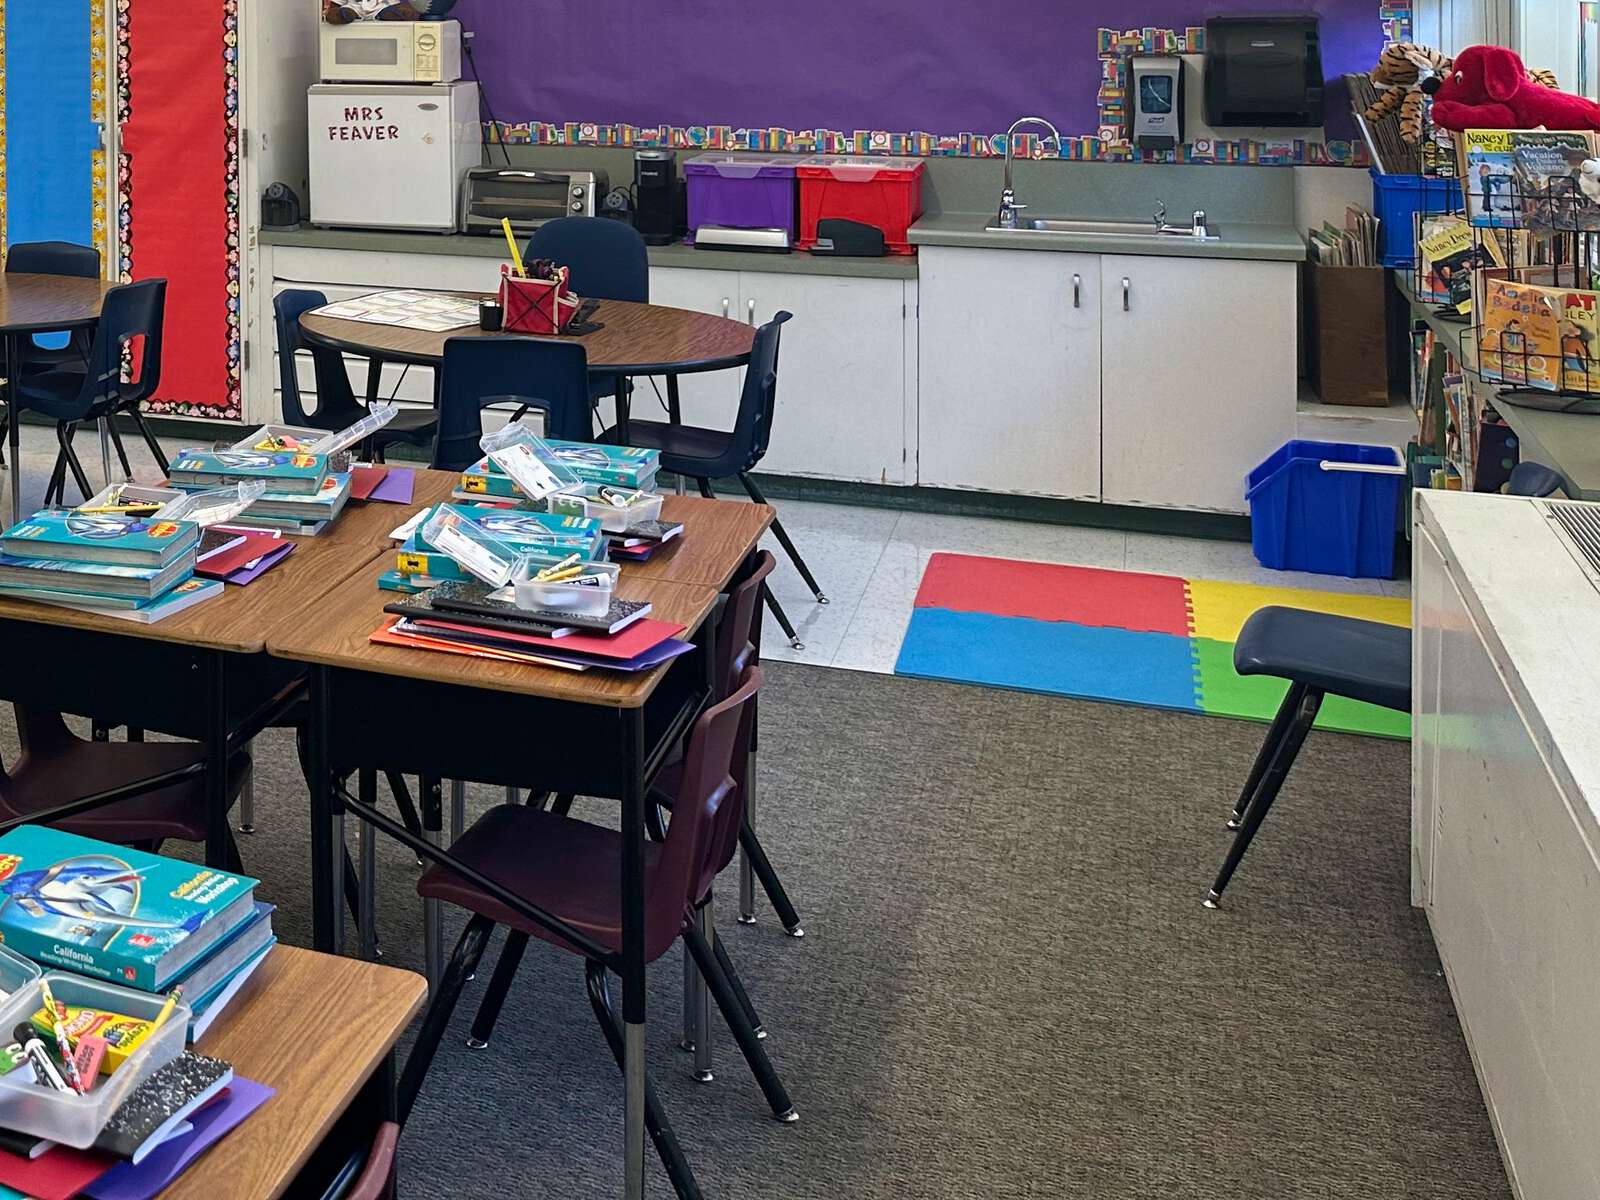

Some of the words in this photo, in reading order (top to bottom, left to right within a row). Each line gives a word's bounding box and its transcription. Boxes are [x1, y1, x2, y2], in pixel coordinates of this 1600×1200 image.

[344, 107, 383, 121] MRS
[328, 125, 399, 140] FEAVER
[1521, 150, 1563, 159] Vacation
[1526, 162, 1564, 171] Volcano
[1493, 295, 1550, 318] Bedelia
[53, 943, 95, 965] California
